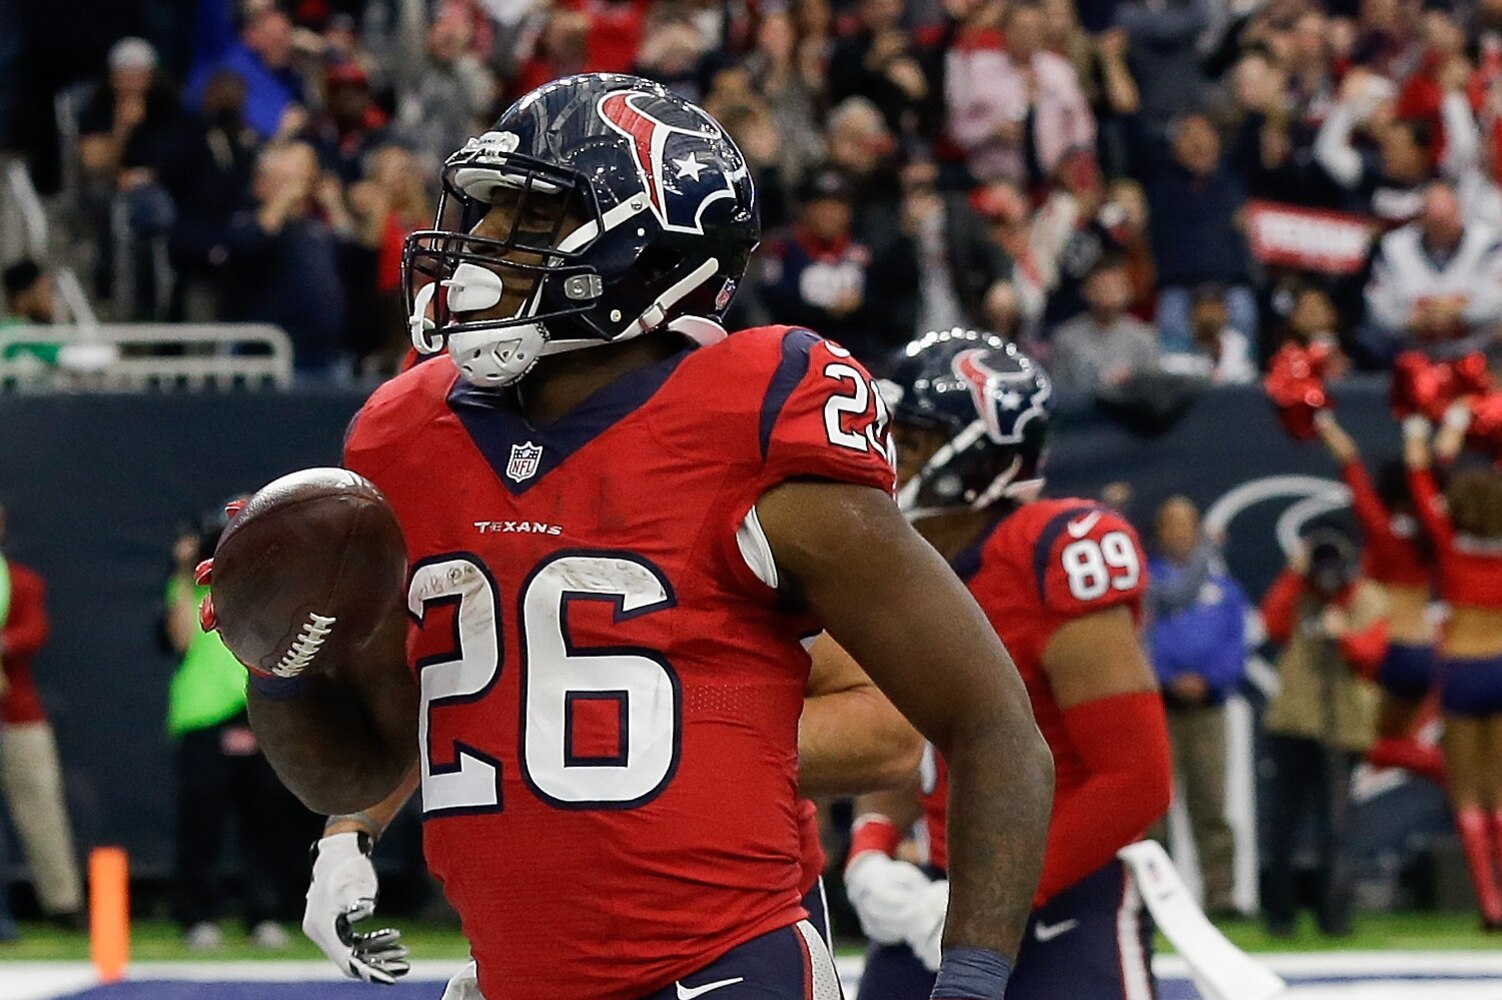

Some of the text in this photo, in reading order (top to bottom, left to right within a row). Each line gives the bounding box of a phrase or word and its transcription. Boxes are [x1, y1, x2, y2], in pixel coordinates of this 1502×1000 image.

[473, 520, 563, 536] TEXANS
[1061, 530, 1140, 601] 89
[408, 551, 682, 817] 26
